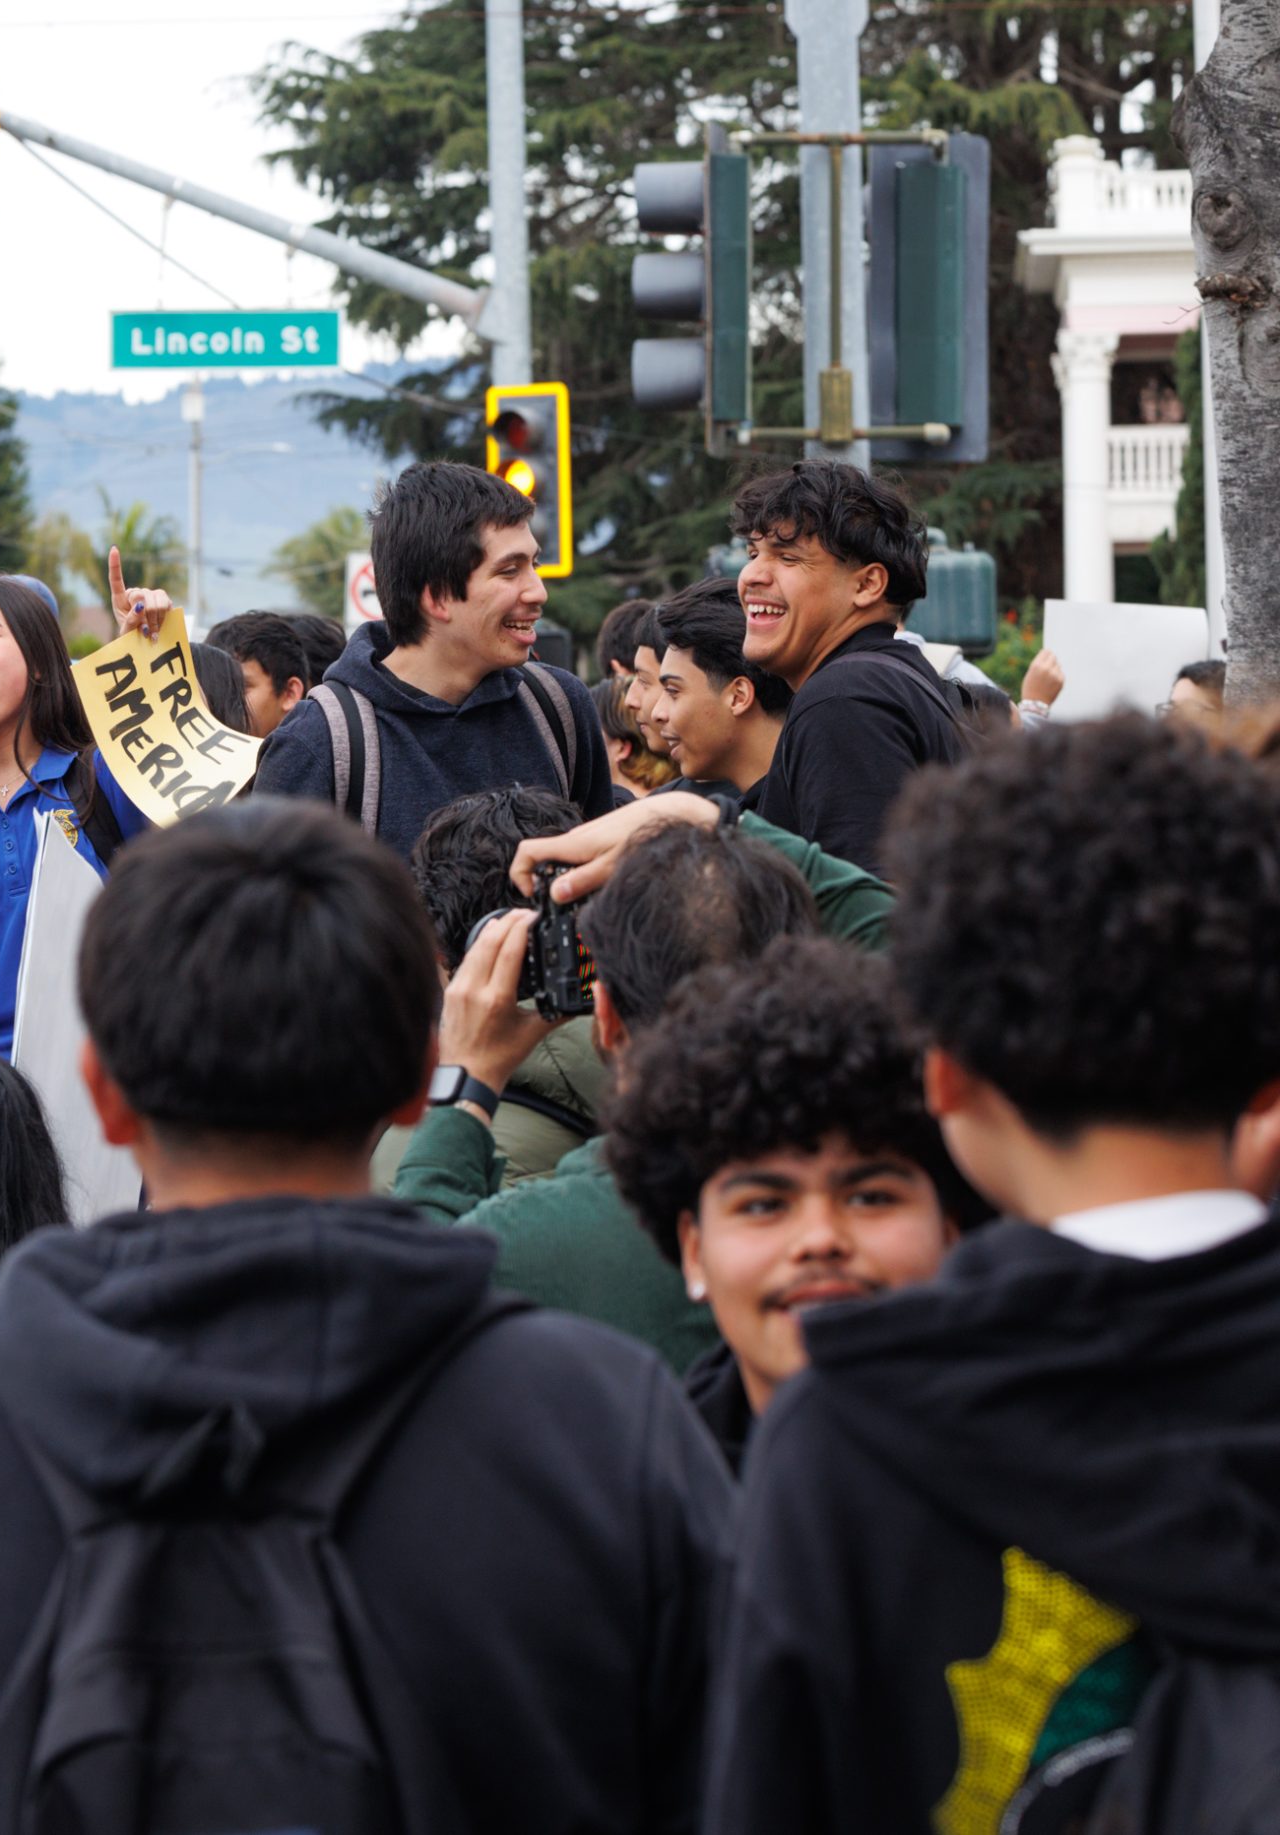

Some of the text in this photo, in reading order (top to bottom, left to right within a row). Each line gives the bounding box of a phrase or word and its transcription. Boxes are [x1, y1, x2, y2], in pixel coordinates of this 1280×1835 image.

[131, 325, 320, 356] Lincoln St
[95, 653, 236, 818] AMERICA
[150, 641, 252, 766] FREE
